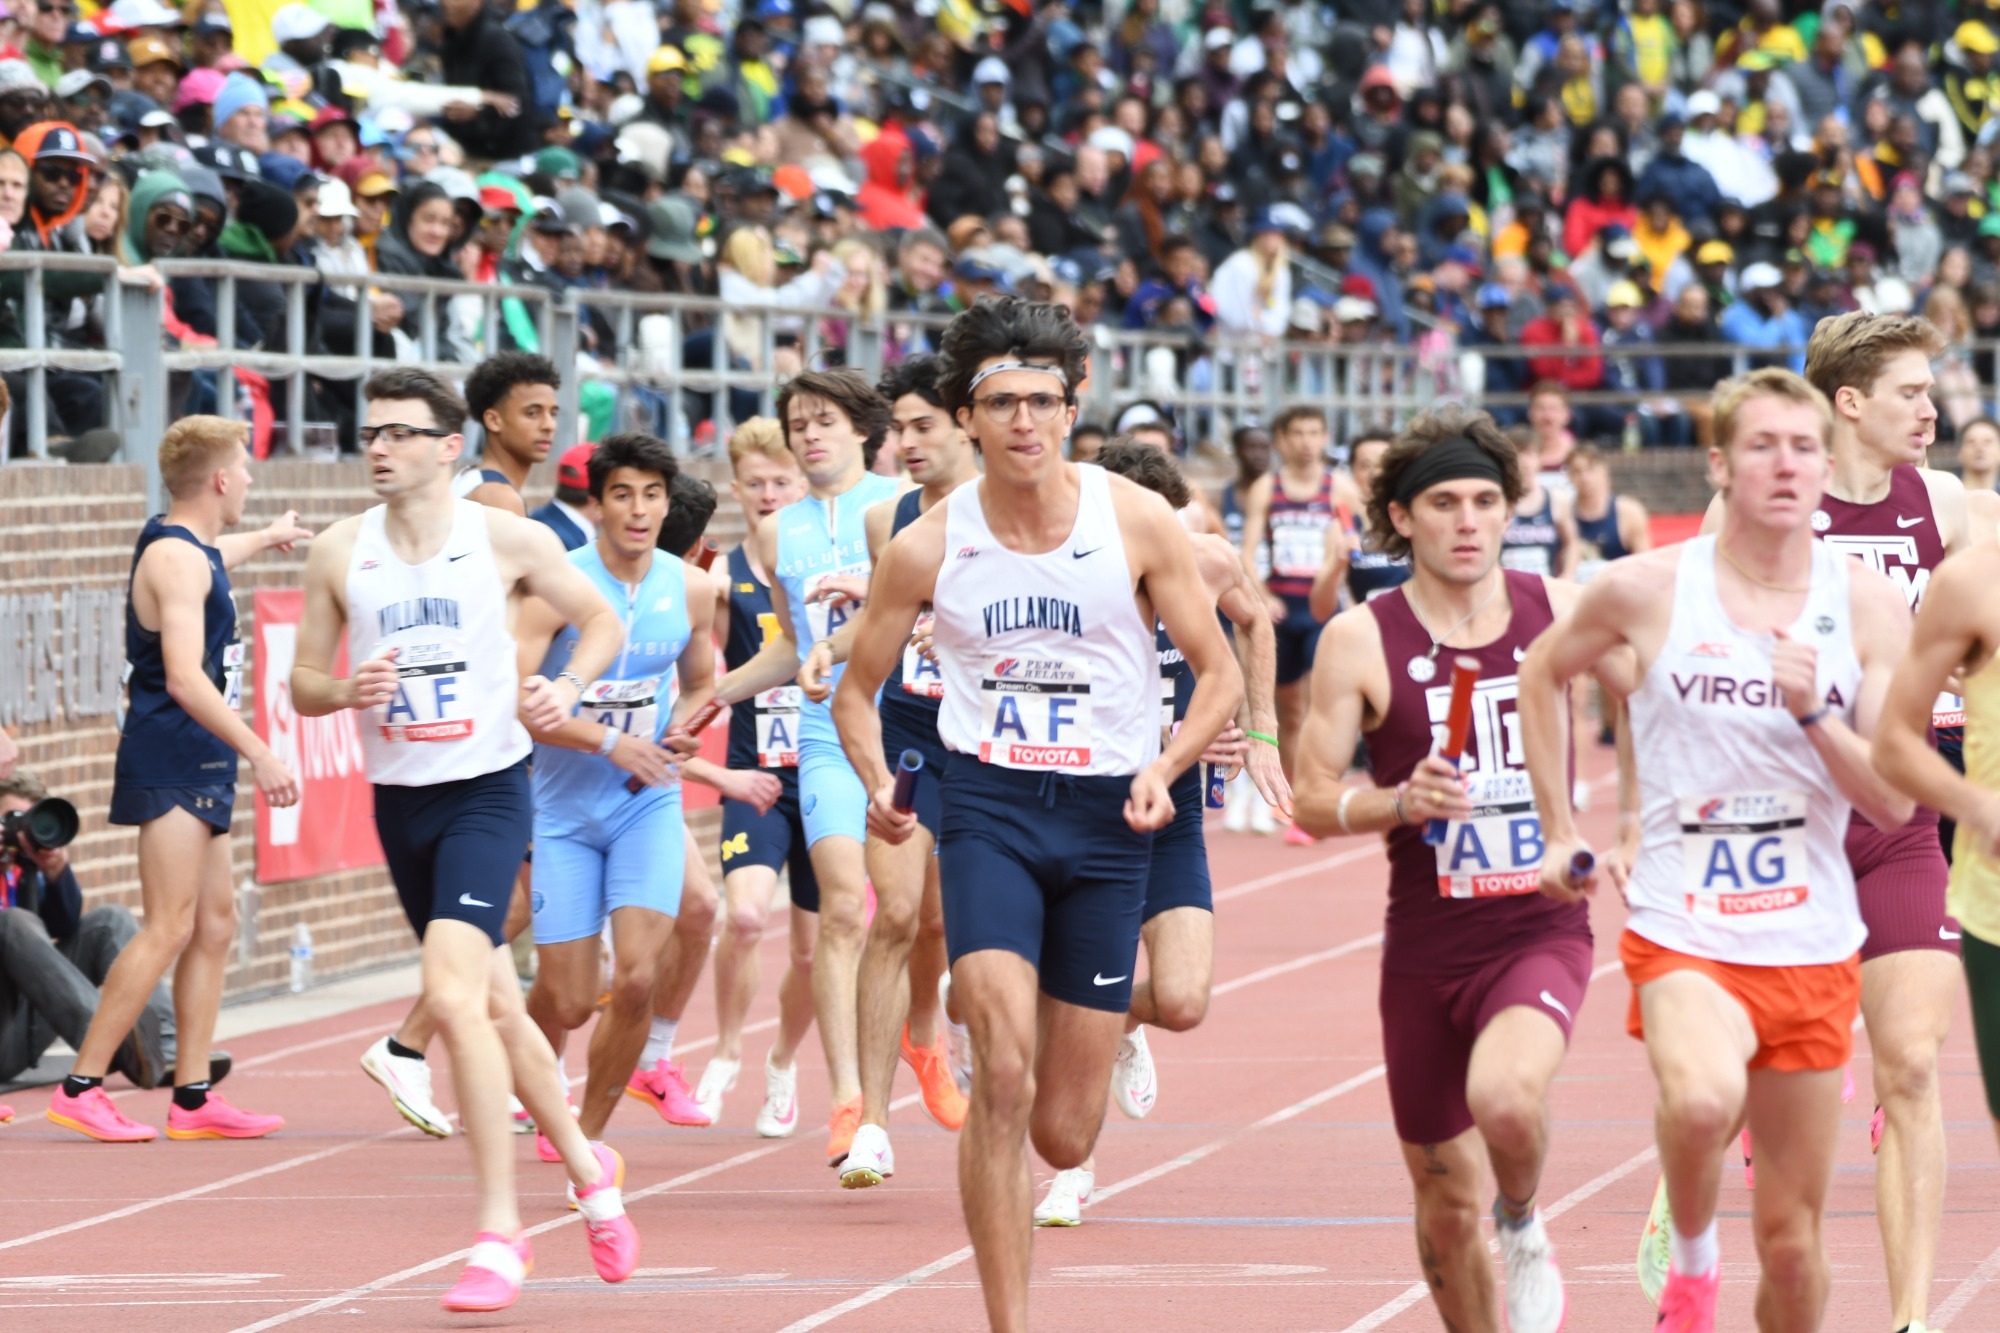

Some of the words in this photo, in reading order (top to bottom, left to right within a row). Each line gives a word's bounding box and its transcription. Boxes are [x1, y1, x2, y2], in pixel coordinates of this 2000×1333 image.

[785, 539, 866, 577] COLUMB
[983, 596, 1083, 638] VILLANOVA
[1024, 670, 1076, 680] RELAYS
[1026, 660, 1063, 670] PENN
[996, 681, 1023, 692] Dream
[1671, 672, 1845, 708] VIRGIA
[766, 717, 792, 749] A
[1011, 746, 1080, 765] TOYOTA
[1702, 836, 1786, 889] AG
[1721, 891, 1797, 910] TOYOTA
